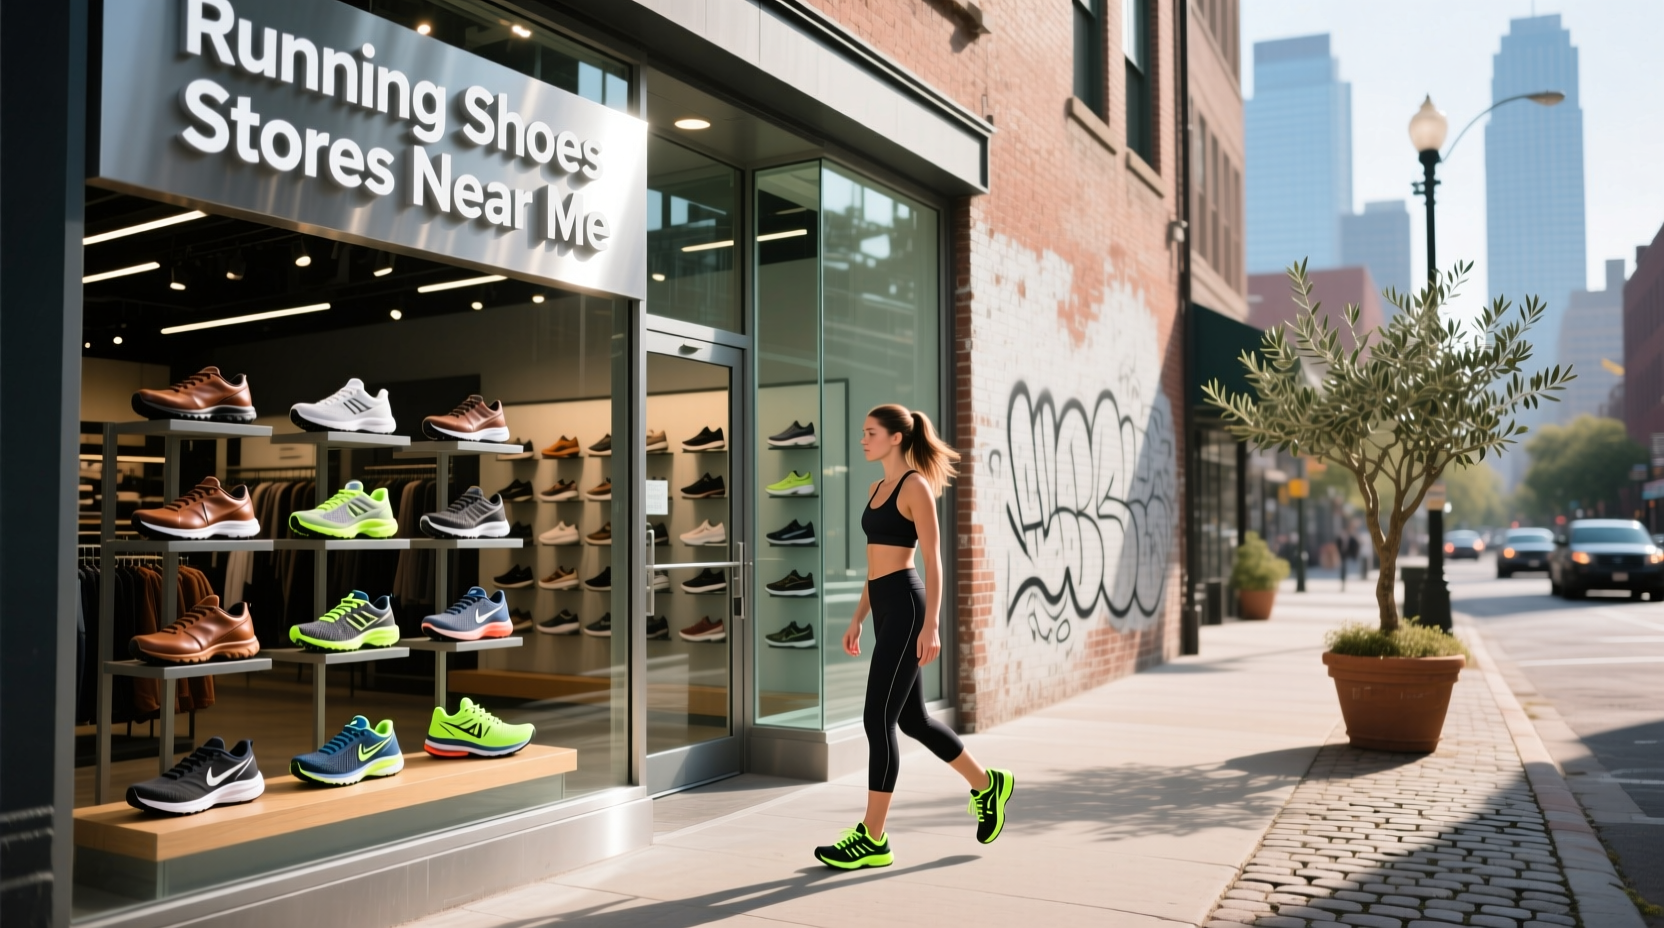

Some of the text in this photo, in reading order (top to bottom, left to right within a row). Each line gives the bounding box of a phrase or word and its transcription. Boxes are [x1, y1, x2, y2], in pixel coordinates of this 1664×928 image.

[181, 79, 611, 251] Stores Near Me
[185, 0, 604, 180] Running Shoes
